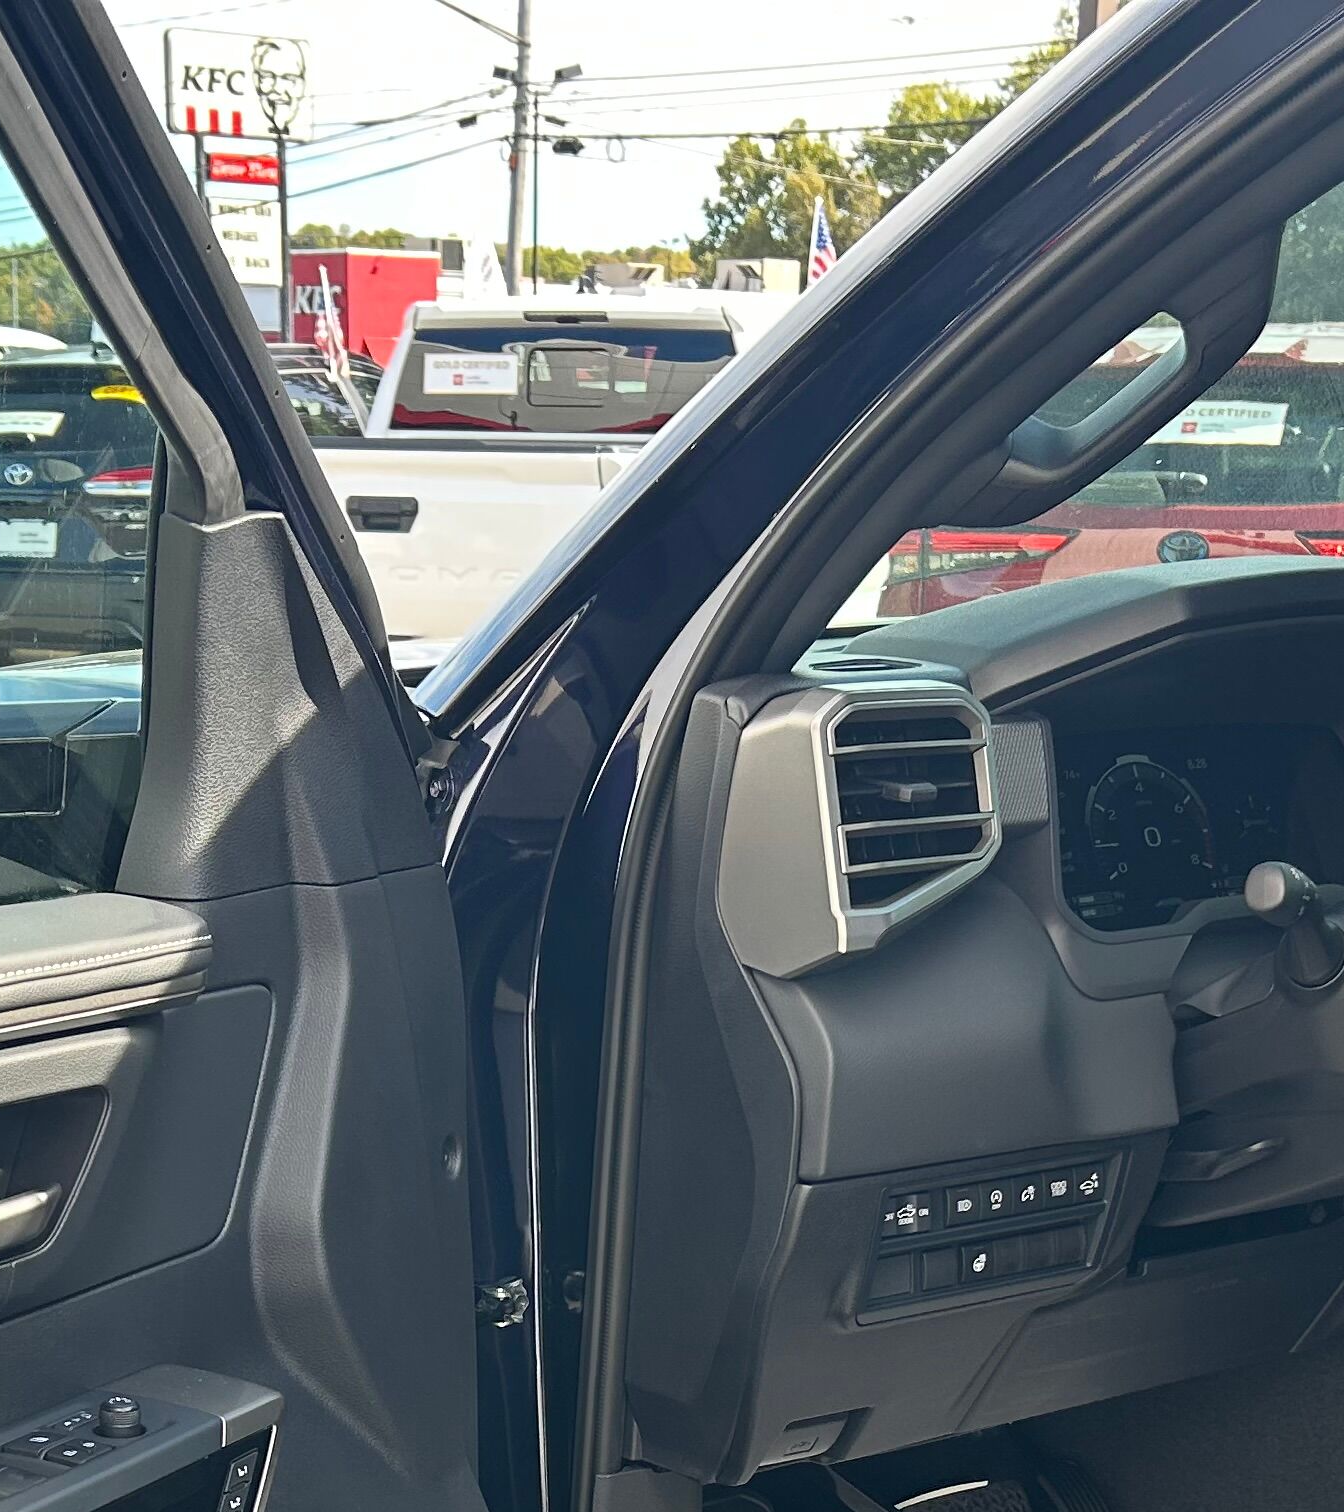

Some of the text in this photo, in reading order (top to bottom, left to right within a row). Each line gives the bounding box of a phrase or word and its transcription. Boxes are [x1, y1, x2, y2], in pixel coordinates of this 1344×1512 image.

[181, 65, 246, 96] KFC
[1198, 408, 1272, 418] CERTIFIED
[1135, 782, 1145, 793] 4
[1174, 804, 1184, 814] 6
[1107, 810, 1117, 821] 2
[1143, 826, 1162, 848] 0
[1118, 862, 1128, 873] 0
